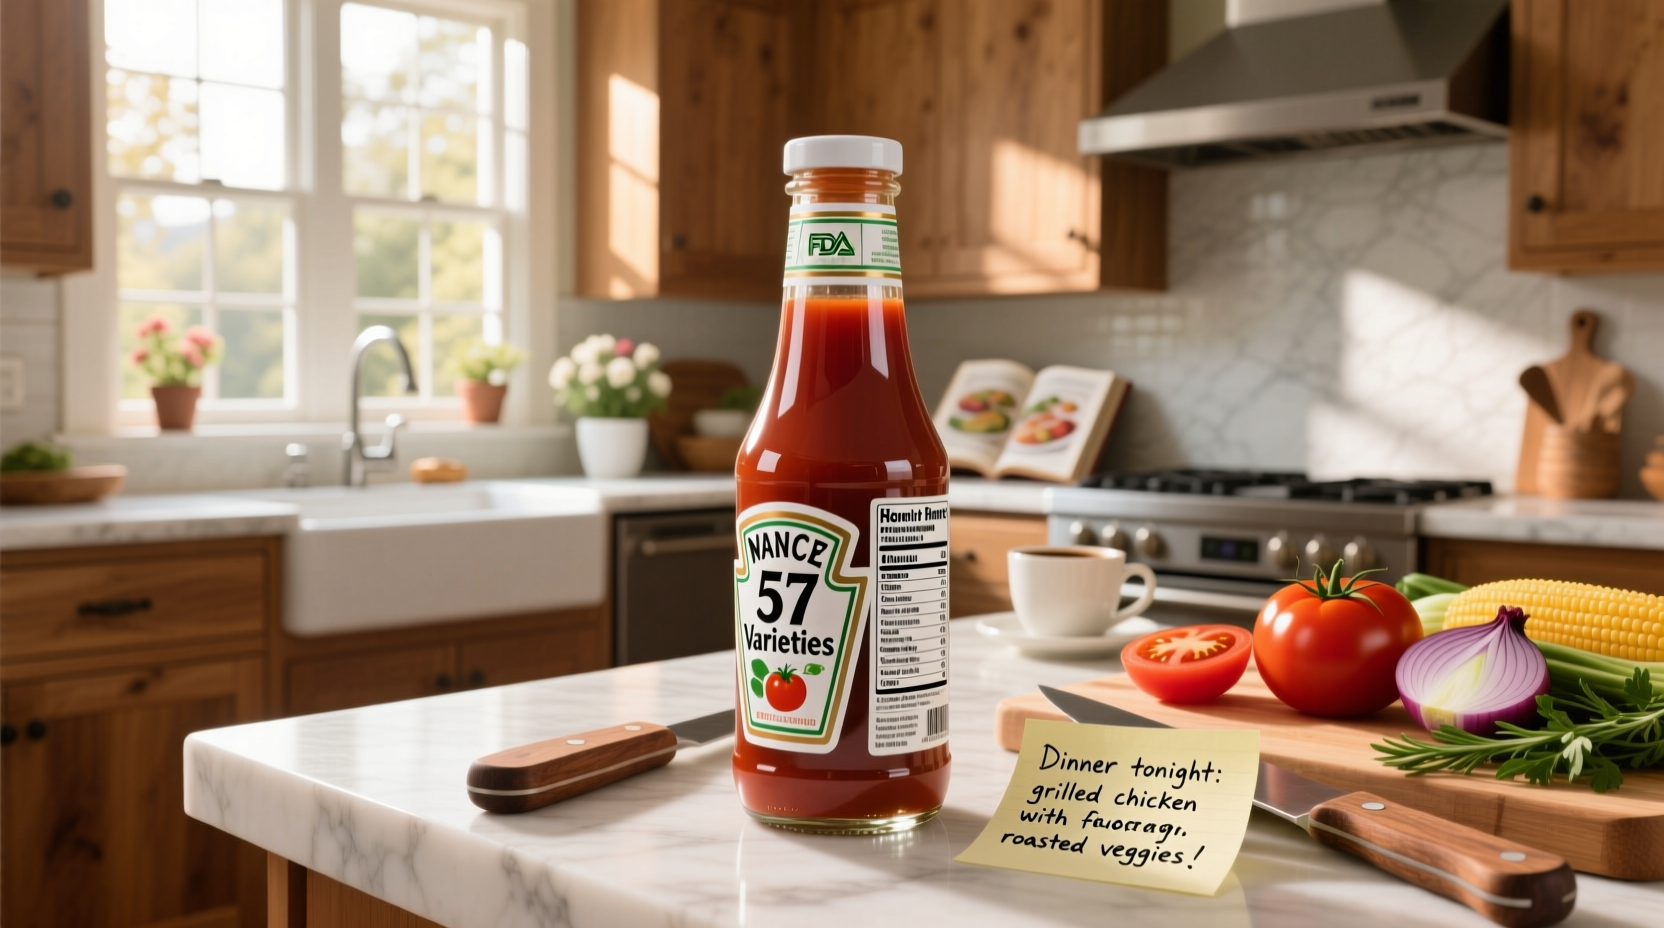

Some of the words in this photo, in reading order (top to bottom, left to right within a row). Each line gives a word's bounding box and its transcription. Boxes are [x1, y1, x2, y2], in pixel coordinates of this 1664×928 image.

[808, 231, 855, 256] FDA
[748, 531, 828, 569] NANCE
[756, 570, 819, 626] 57
[744, 623, 834, 657] Varieties
[1039, 743, 1118, 774] Dinner
[1130, 757, 1222, 790] tonight:
[1026, 782, 1103, 805] grilled
[1114, 788, 1197, 812] chicken
[1020, 807, 1067, 826] with
[1000, 831, 1088, 854] roasted
[1101, 845, 1205, 869] veggies!
